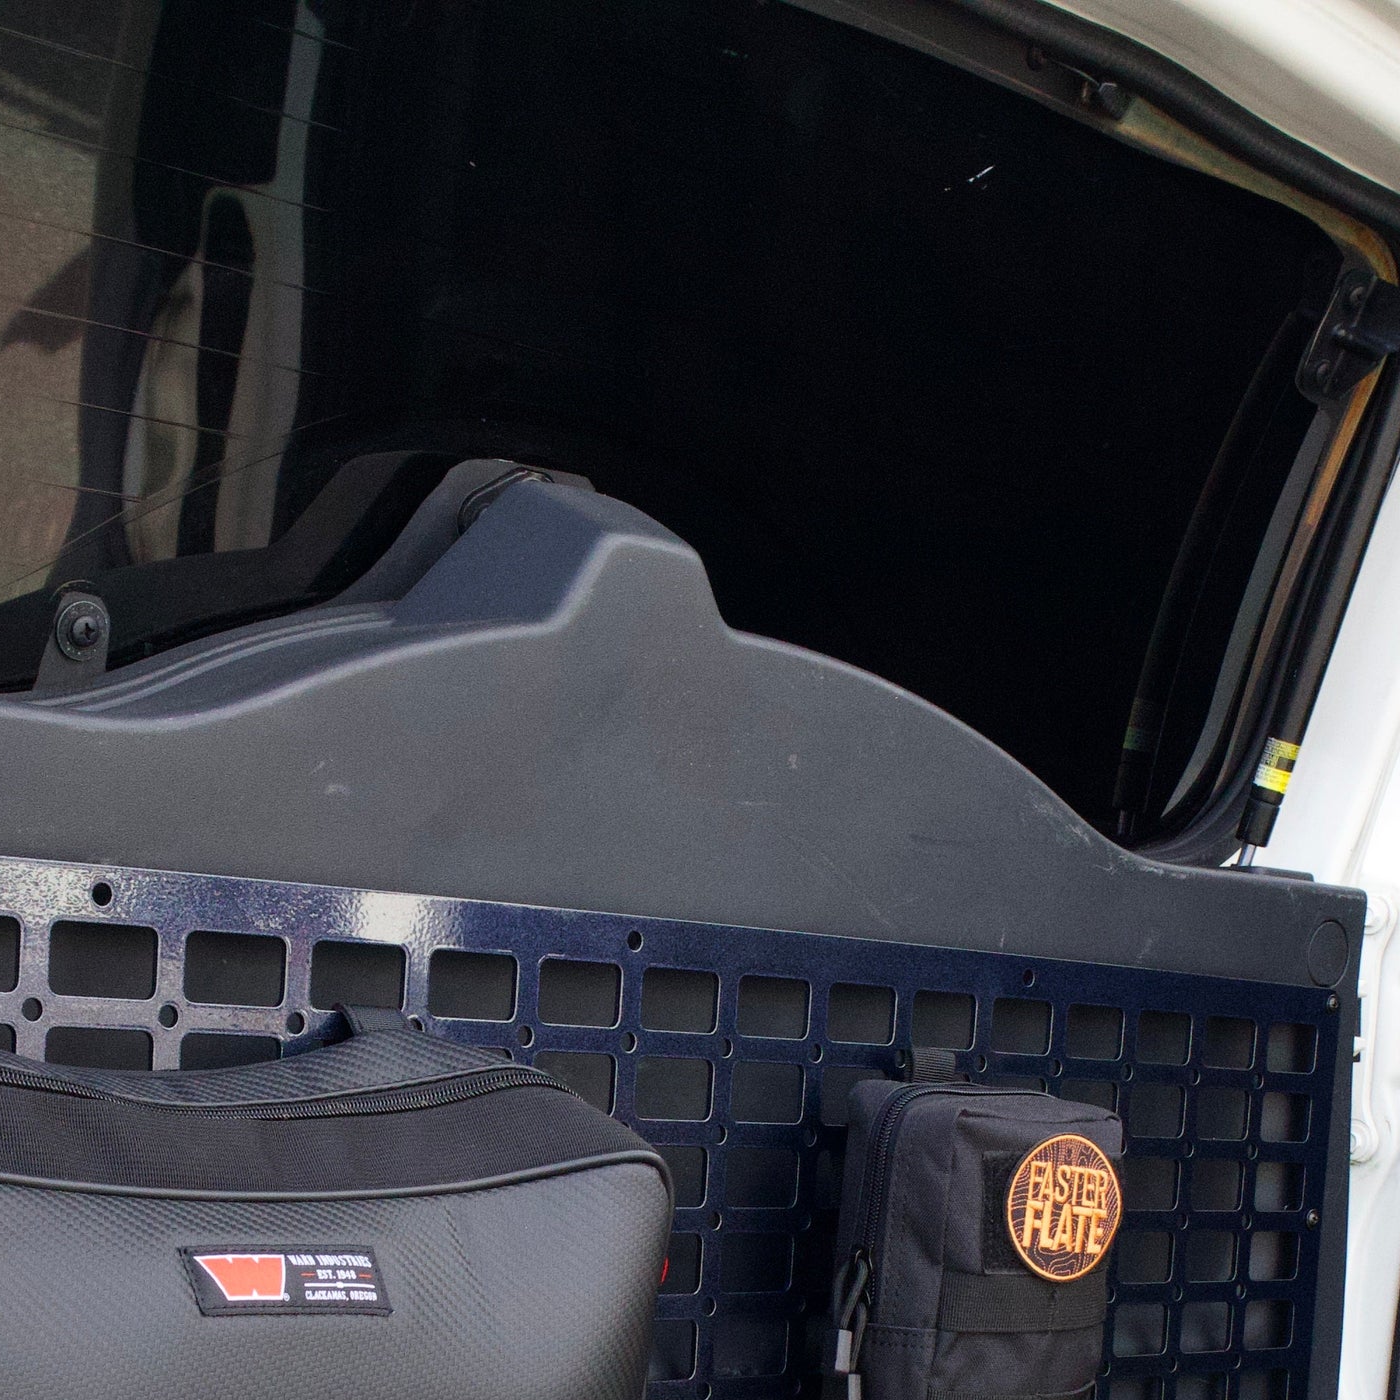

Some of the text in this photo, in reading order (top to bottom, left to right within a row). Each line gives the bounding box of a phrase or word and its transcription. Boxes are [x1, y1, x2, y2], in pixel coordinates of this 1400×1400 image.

[1028, 1161, 1108, 1210] FASTER
[1022, 1200, 1108, 1253] FLATE
[287, 1254, 372, 1268] WARN INDUSTRIES
[316, 1269, 357, 1280] EST. 1948
[350, 1290, 378, 1301] OREGON
